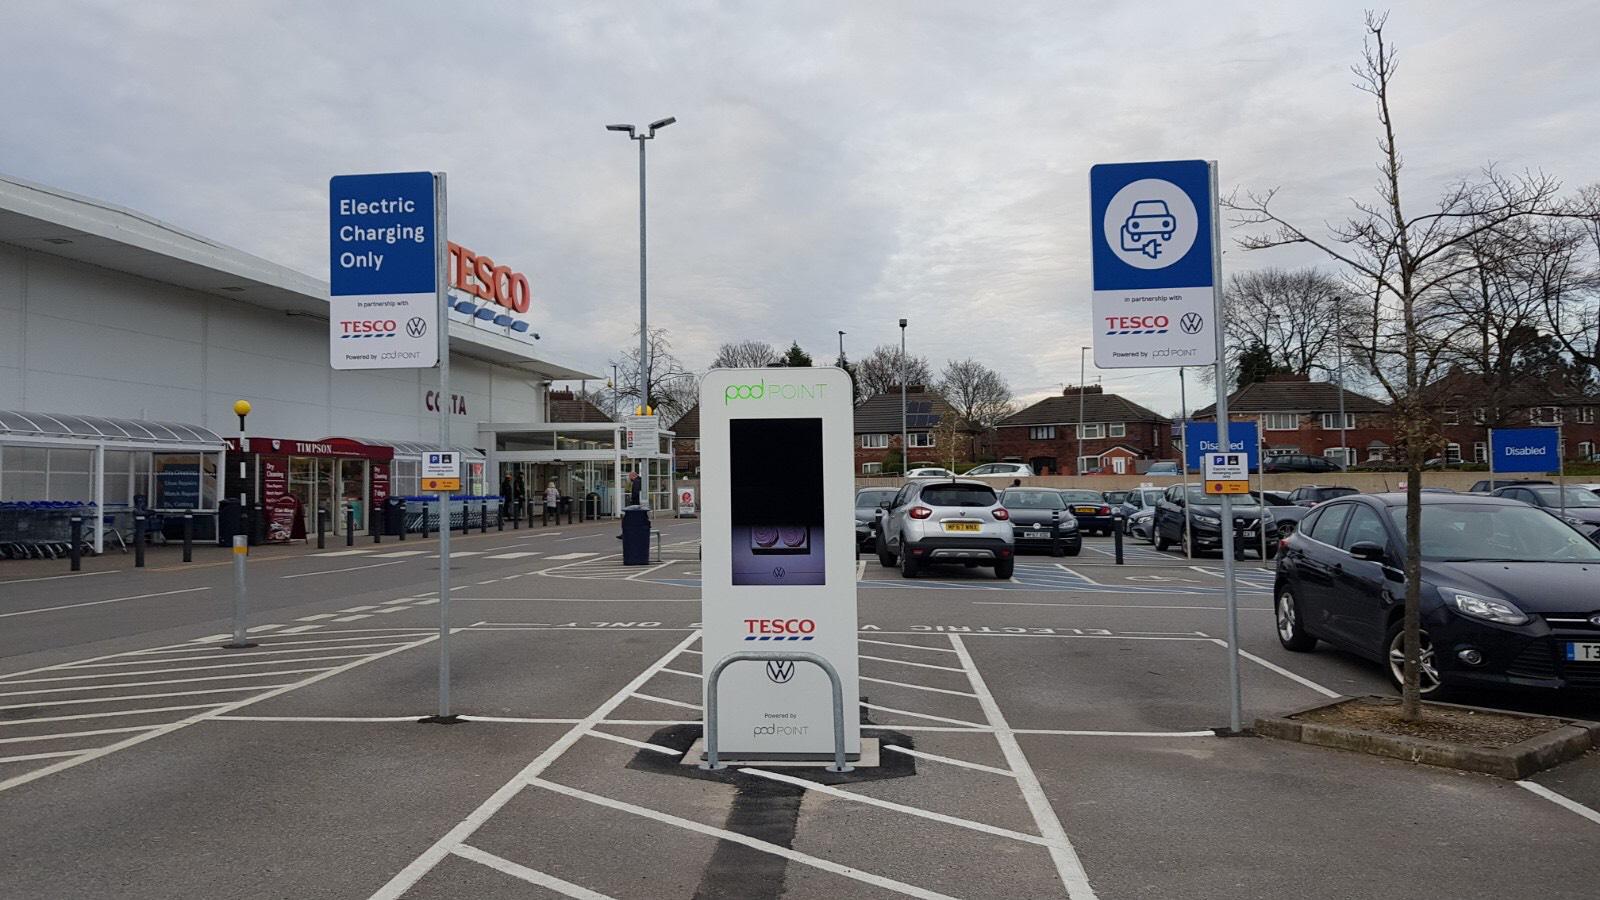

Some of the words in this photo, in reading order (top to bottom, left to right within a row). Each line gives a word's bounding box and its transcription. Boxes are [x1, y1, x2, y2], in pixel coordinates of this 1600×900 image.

[340, 197, 415, 215] Electric
[340, 224, 425, 244] Charging
[340, 251, 384, 271] Only
[340, 320, 397, 333] TESCO
[1105, 316, 1169, 329] TESCO
[768, 383, 827, 400] POINT
[425, 390, 467, 415] COTA
[296, 442, 332, 454] TIMPSON
[1200, 440, 1244, 450] Disaed
[1505, 446, 1546, 456] Disabled
[744, 619, 816, 634] TESCO
[910, 625, 1113, 635] ELECTRIC
[777, 726, 809, 736] POINT
